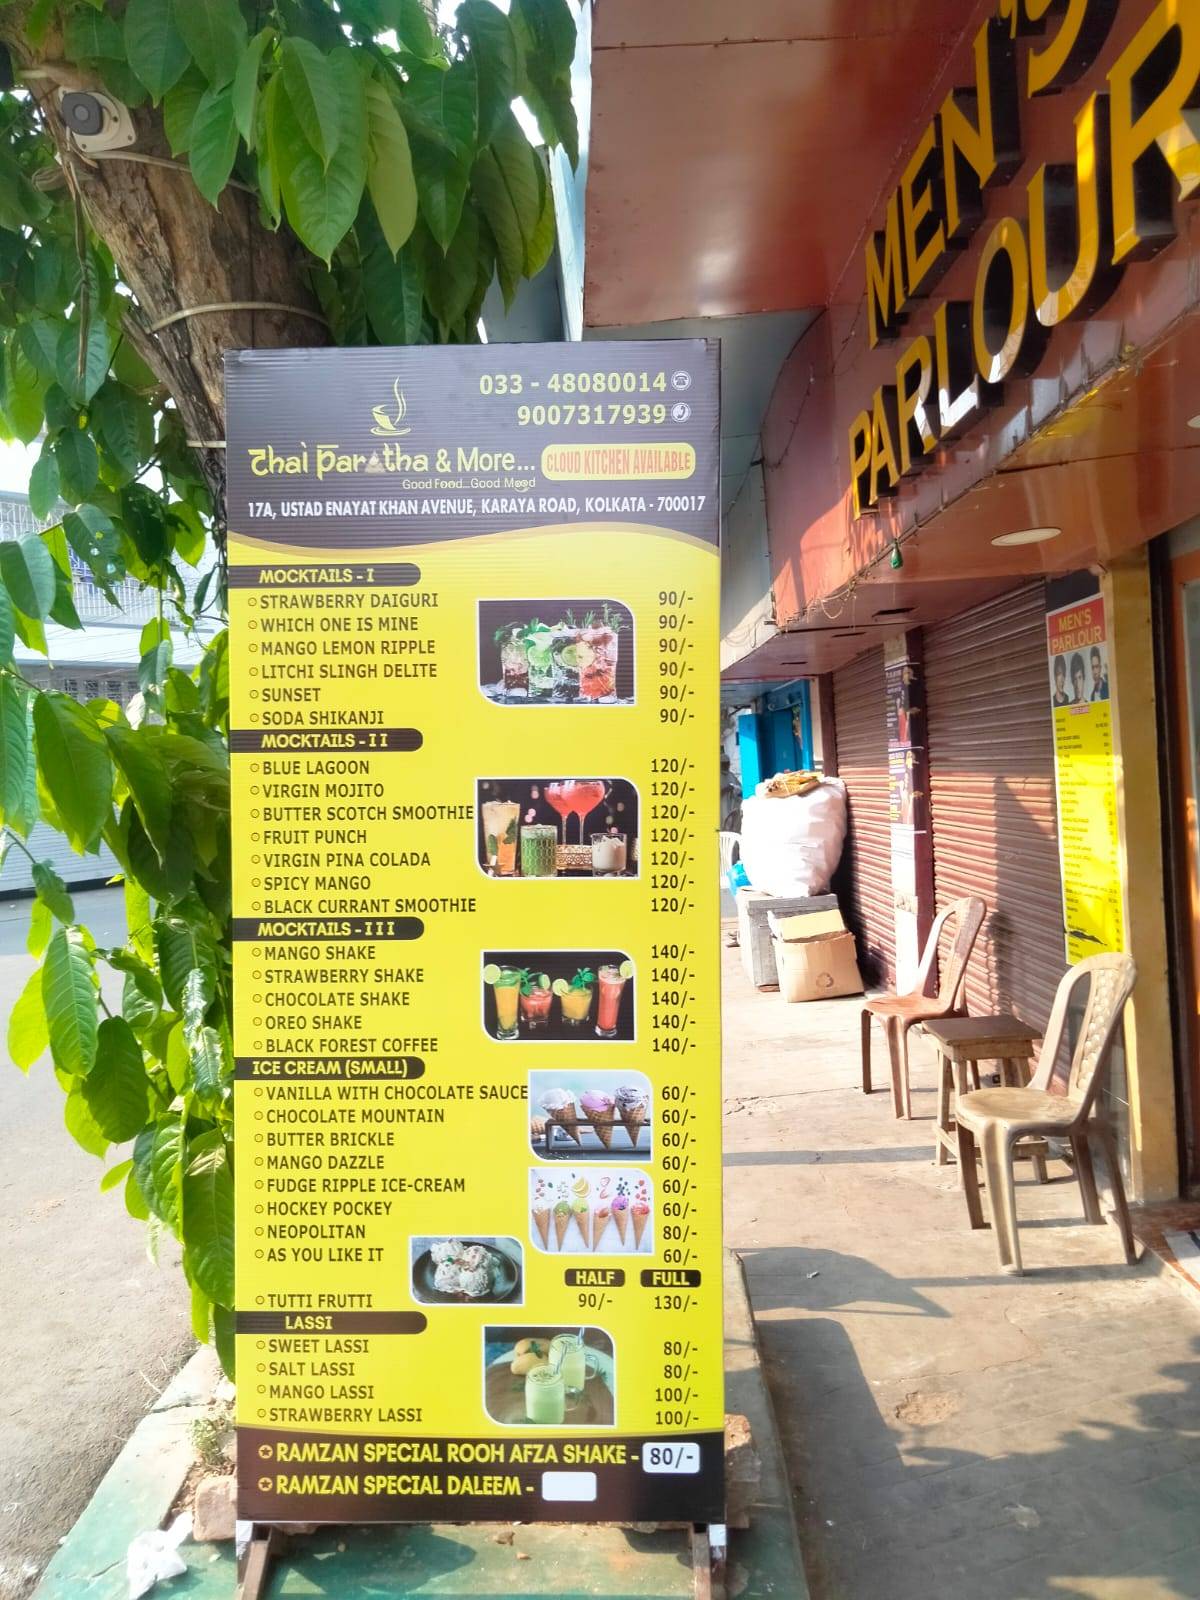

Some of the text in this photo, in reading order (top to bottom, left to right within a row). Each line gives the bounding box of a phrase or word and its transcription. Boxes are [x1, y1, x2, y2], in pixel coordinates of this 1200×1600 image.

[848, 0, 1200, 521] PARLOUR
[479, 375, 523, 394] 033
[547, 373, 667, 392] 48080014
[517, 404, 666, 425] 9007317939
[247, 442, 308, 476] Chai
[434, 449, 455, 472] &
[546, 448, 692, 474] CLOUD KITCHEN AVAILABLE
[401, 479, 433, 489] Good
[248, 502, 277, 519] 17A,
[280, 502, 323, 516] USTAD
[325, 501, 377, 515] ENAYAT
[378, 500, 419, 515] KHAN
[420, 499, 477, 516] AVENUE,
[481, 498, 536, 513] KARAYA
[538, 498, 581, 515] ROAD,
[585, 497, 647, 512] KOLKATA
[657, 496, 706, 511] 700017
[258, 569, 353, 583] MOCKTAILS
[366, 568, 375, 582] I
[260, 592, 439, 610] STRAWBERRY DAIGURI
[658, 590, 694, 609] 90/-
[260, 616, 419, 633] WHICH ONE IS MINE
[658, 613, 694, 632] 90/-
[1059, 608, 1092, 632] MEN'S
[261, 639, 436, 656] MANGO LEMON RIPPLE
[659, 637, 694, 656] 90/-
[1052, 625, 1102, 653] PARLOUR
[261, 663, 437, 679] LITCHI SLINGH DELITE
[659, 661, 694, 679] 90/-
[262, 687, 321, 703] SUNSET
[659, 684, 695, 703] 90/-
[262, 710, 387, 726] SODA SHIKANJI
[659, 708, 695, 726] 90/-
[260, 734, 356, 748] MOCKTAILS
[262, 760, 370, 776] BLUE LAGOON
[651, 757, 695, 776] 120/-
[262, 782, 385, 799] VIRGIN MOJITO
[651, 781, 695, 799] 120/-
[263, 805, 474, 822] BUTTER SCOTCH SMOOTHIE
[651, 804, 695, 822] 120/-
[263, 829, 367, 845] FRUIT PUNCH
[651, 827, 695, 845] 120/-
[263, 851, 431, 868] VIRGIN PINA COLADA
[651, 850, 695, 869] 120/-
[263, 875, 371, 891] SPICY MANGO
[651, 874, 695, 892] 120/-
[264, 897, 476, 914] BLACK CURRANT SMOOTHIE
[651, 897, 695, 915] 120/-
[257, 922, 352, 936] MOCKTAILS
[265, 945, 376, 960] MANGO SHAKE
[651, 943, 695, 962] 140/-
[264, 968, 424, 984] STRAWBERRY SHAKE
[651, 967, 695, 985] 140/-
[265, 991, 410, 1007] CHOCOLATE SHAKE
[652, 990, 696, 1009] 140/-
[265, 1015, 362, 1030] OREO SHAKE
[652, 1013, 696, 1032] 140/-
[266, 1037, 438, 1053] BLACK FOREST COFFEE
[652, 1037, 696, 1055] 140/-
[252, 1059, 408, 1078] ICE CREAM (SMALL)
[265, 1085, 529, 1101] VANILLA WITH CHOCOLATE SAUCE
[661, 1085, 696, 1103] 60/-
[266, 1108, 445, 1124] CHOCOLATE MOUNTAIN
[661, 1108, 696, 1127] 60/-
[267, 1132, 395, 1147] BUTTER BRICKLE
[662, 1132, 697, 1150] 60/-
[267, 1155, 385, 1170] MANGO DAZZLE
[662, 1155, 697, 1173] 60/-
[267, 1177, 465, 1193] FUDGE RIPPLE ICE-CREAM
[662, 1178, 697, 1197] 60/-
[267, 1201, 393, 1216] HOCKEY POCKEY
[662, 1202, 697, 1220] 60/-
[267, 1224, 366, 1239] NEOPOLITAN
[662, 1225, 697, 1243] 80/-
[267, 1247, 385, 1262] AS YOU LIKE IT
[663, 1248, 698, 1266] 60/-
[574, 1271, 615, 1284] HALF
[651, 1272, 693, 1285] FULL
[266, 1293, 375, 1309] TUTTI FRUTTI
[578, 1292, 613, 1311] 90/-
[654, 1295, 698, 1313] 130/-
[285, 1316, 333, 1329] LASSI
[268, 1338, 369, 1354] SWEET LASSI
[663, 1341, 698, 1359] 80/-
[268, 1361, 355, 1377] SALT LASSI
[663, 1364, 699, 1382] 80/-
[269, 1384, 374, 1400] MANGO LASSI
[655, 1387, 699, 1405] 100/-
[269, 1407, 423, 1423] STRAWBERRY LASSI
[655, 1410, 699, 1428] 100/-
[276, 1443, 359, 1462] RAMZAN
[363, 1443, 443, 1462] SPECIAL
[447, 1444, 505, 1462] ROOH
[509, 1444, 559, 1463] AFZA
[563, 1444, 626, 1464] SHAKE
[650, 1447, 694, 1469] 80/-
[276, 1475, 359, 1494] RAMZAN
[363, 1475, 443, 1494] SPECIAL
[447, 1476, 522, 1495] DALEEM
